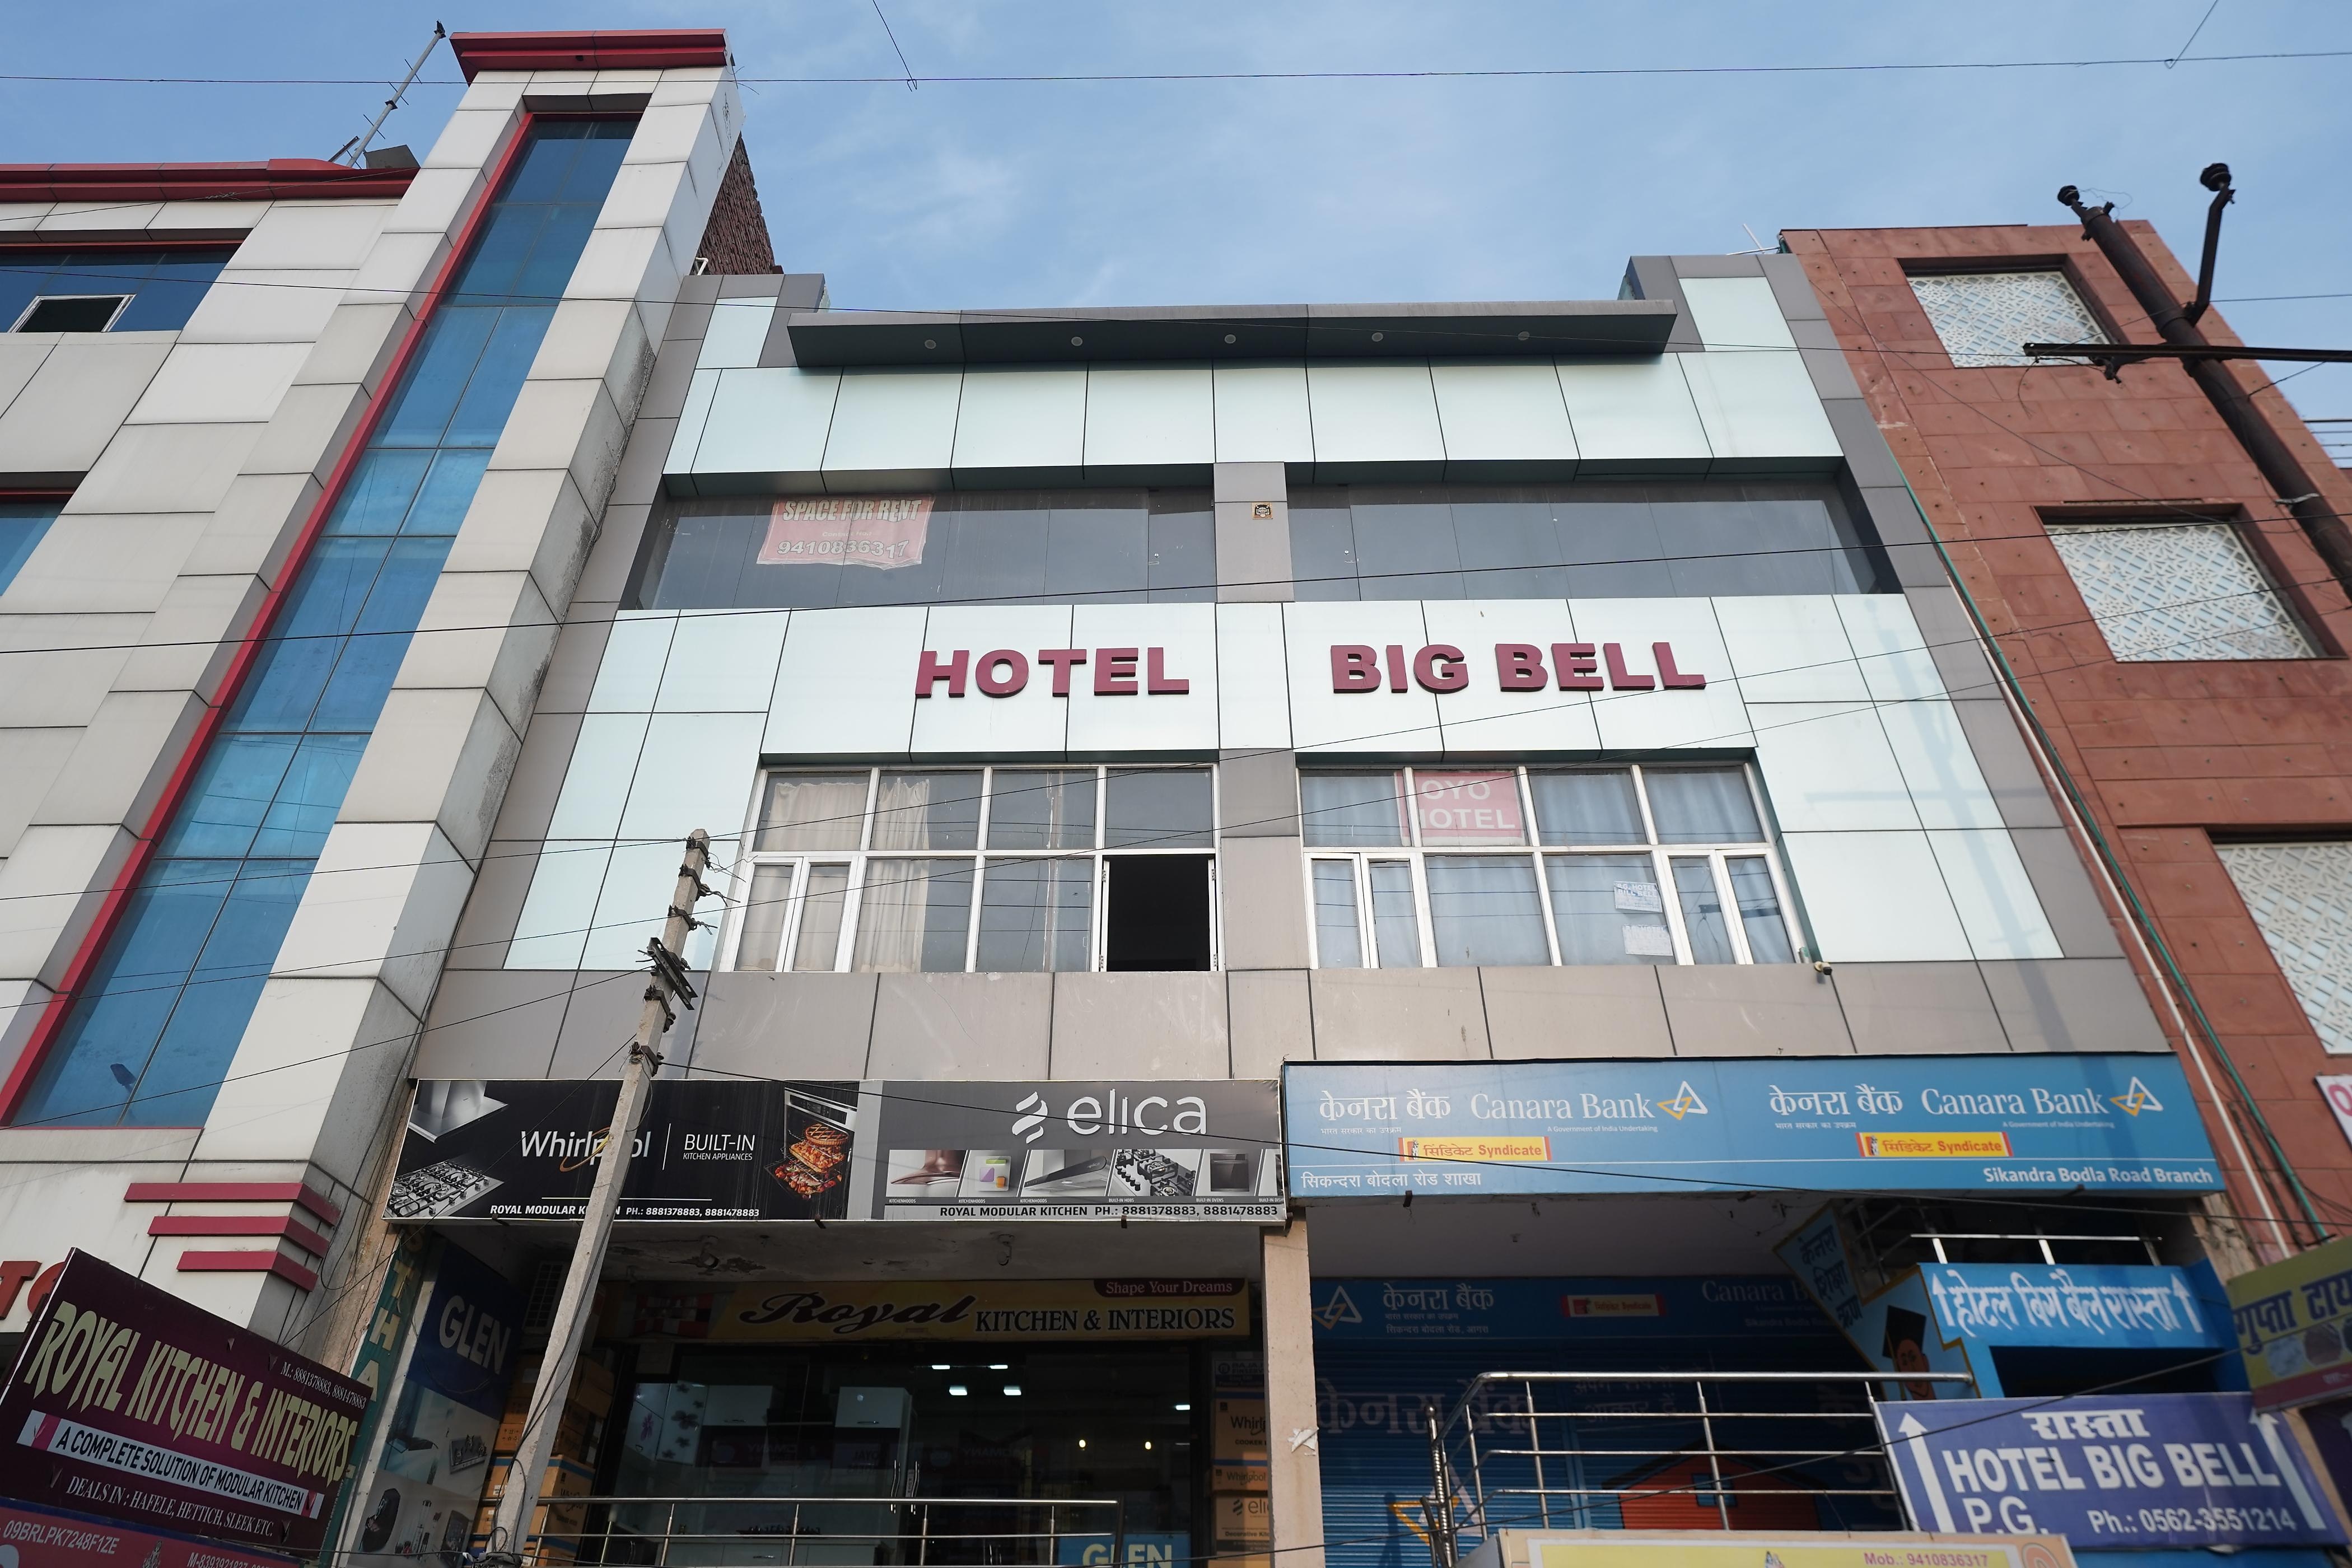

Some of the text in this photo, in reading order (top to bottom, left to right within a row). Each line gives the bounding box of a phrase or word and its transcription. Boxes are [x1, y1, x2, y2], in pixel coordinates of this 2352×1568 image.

[783, 498, 923, 523] SPACE FOR RENT
[777, 540, 909, 559] 9410836317
[915, 641, 1706, 698] HOTEL BIG BELL
[1421, 780, 1491, 800] OYO
[1067, 1089, 1207, 1135] elica
[1319, 1088, 1450, 1122] केनरा बैंक
[1471, 1092, 1655, 1119] Canara Bank
[1768, 1082, 1903, 1117] केनरा बैंक
[1921, 1088, 2110, 1116] Canara Bank
[520, 1130, 651, 1166] Whirlpol
[684, 1134, 755, 1152] BUILT-IN
[1423, 1143, 1473, 1157] सिंडिकेट
[1478, 1144, 1542, 1159] Syndicate
[1882, 1139, 1934, 1152] सिंडिकेट
[1938, 1140, 2003, 1155] Syndicate
[683, 1152, 753, 1161] KITCHEN APPLIANCES
[1301, 1168, 1482, 1189] सिकन्दरा बोदला रोड शाखा
[1983, 1166, 2214, 1184] Sikandra Bodla Road Branch
[491, 1205, 522, 1215] ROYAL
[525, 1205, 573, 1215] MODULAR
[626, 1207, 643, 1216] PH.:
[645, 1208, 704, 1217] 8881378883,
[705, 1208, 759, 1217] 8881478883
[940, 1206, 1278, 1217] ROYAL MODULAR KITCHEN PH.: 8881378883, 8881478883
[1105, 1280, 1233, 1296] Shape Your Dreams
[1382, 1282, 1495, 1310] केनरा बैंक
[1702, 1280, 1785, 1303] Canara
[739, 1290, 978, 1334] Royal
[1946, 1269, 2014, 1337] होटल
[2010, 1272, 2069, 1328] बिग
[974, 1307, 1236, 1332] KITCHEN & INTERIORS
[438, 1295, 511, 1375] GLEN
[24, 1300, 358, 1488] ROYAL KITCHEN & INTERIORS
[293, 1367, 332, 1398] 8881378883,
[332, 1384, 367, 1410] 8881478883
[2020, 1408, 2150, 1441] रास्ता
[56, 1426, 304, 1511] A COMPLETE SOLUTION OF MODULAR KITCHEN
[1226, 1471, 1266, 1483] Whirlpool
[1942, 1446, 2087, 1494] HOTEL
[2082, 1444, 2166, 1490] BIG
[2163, 1442, 2281, 1488] BELL
[66, 1476, 111, 1504] DEALS
[109, 1485, 124, 1505] IN
[129, 1492, 176, 1519] HAFELE,
[175, 1501, 224, 1527] HETTICH,
[223, 1511, 255, 1533] SLEEK
[254, 1519, 274, 1537] ETC.
[1962, 1496, 2298, 1534] P.G. Ph.: 0562-3551214
[3, 1519, 120, 1555] 09BRLPK7248F1ZE
[1865, 1552, 1989, 1568] Mob.: 9410836317
